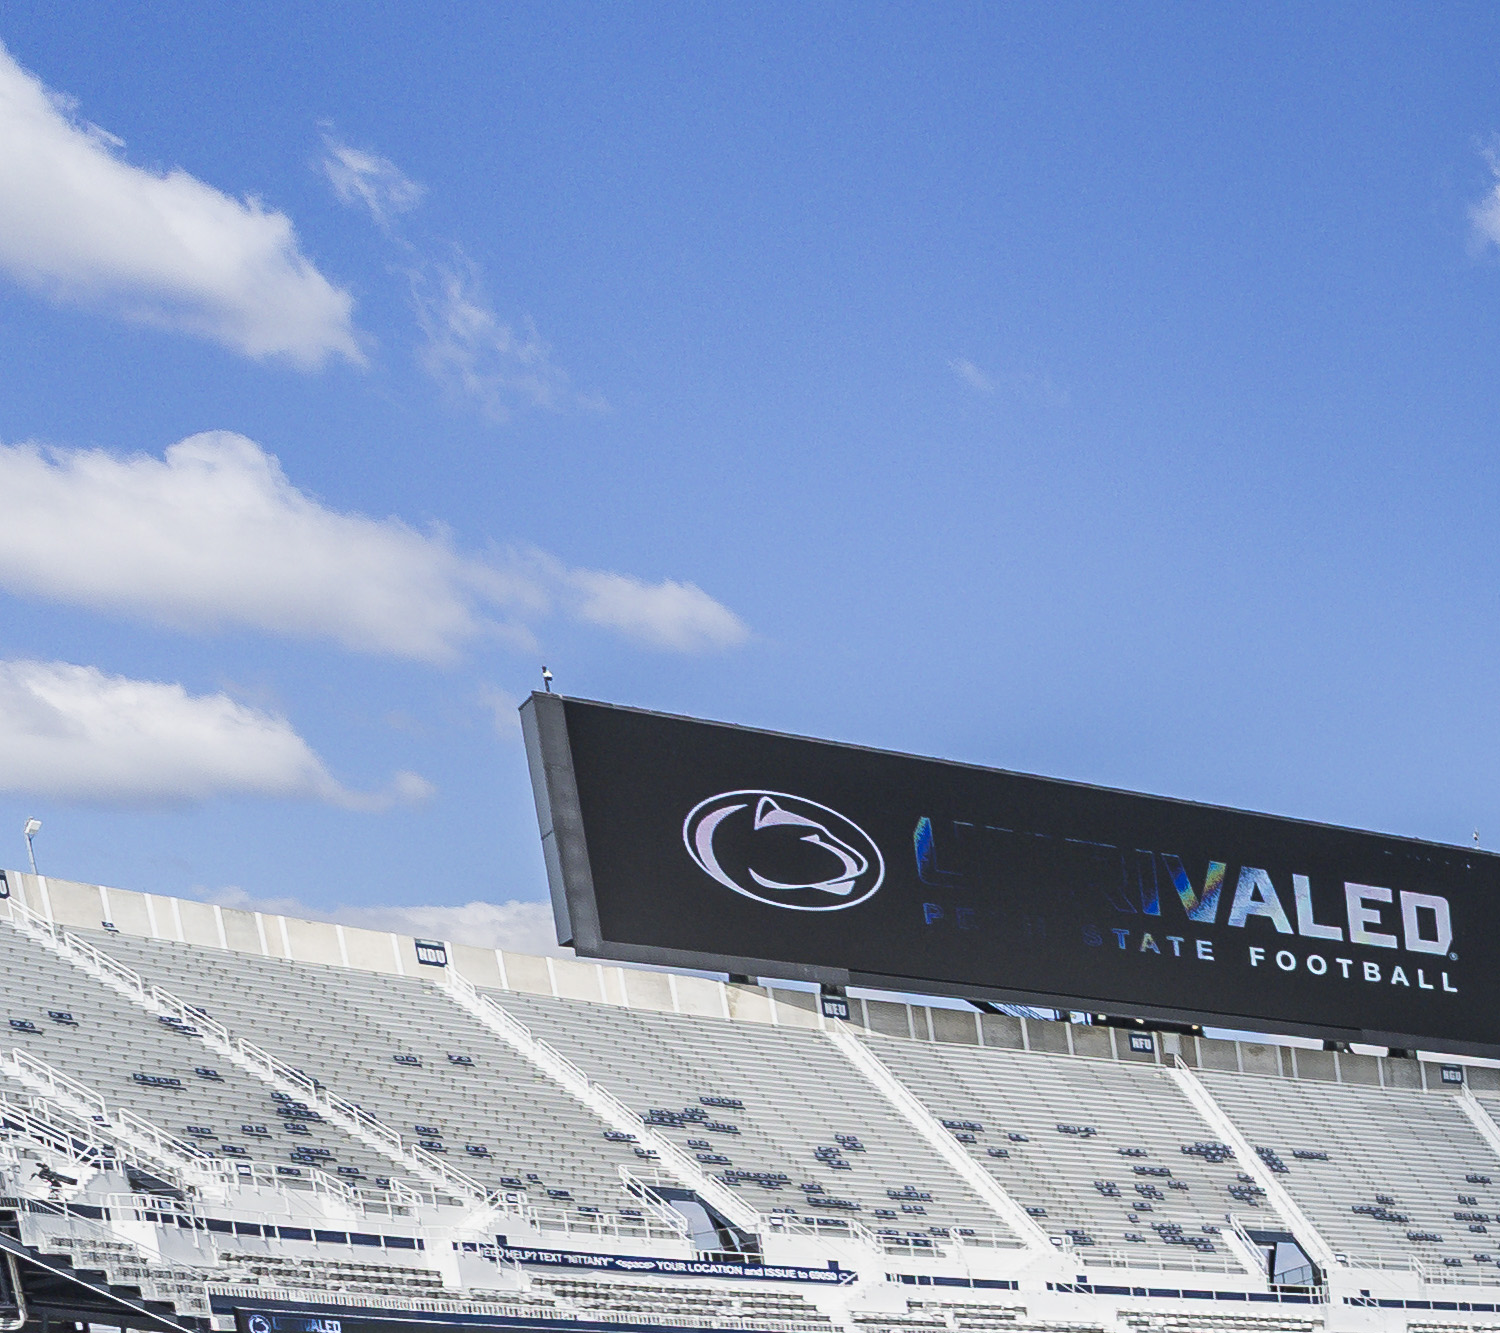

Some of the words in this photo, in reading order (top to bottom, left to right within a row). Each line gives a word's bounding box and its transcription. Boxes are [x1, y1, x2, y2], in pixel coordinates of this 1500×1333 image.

[1248, 945, 1460, 993] FOOTBALL
[539, 1252, 562, 1264] TEXT
[657, 1261, 687, 1273] YOUR
[688, 1263, 742, 1276] LOCATION
[743, 1266, 763, 1277] and
[765, 1268, 797, 1279] ISSUE
